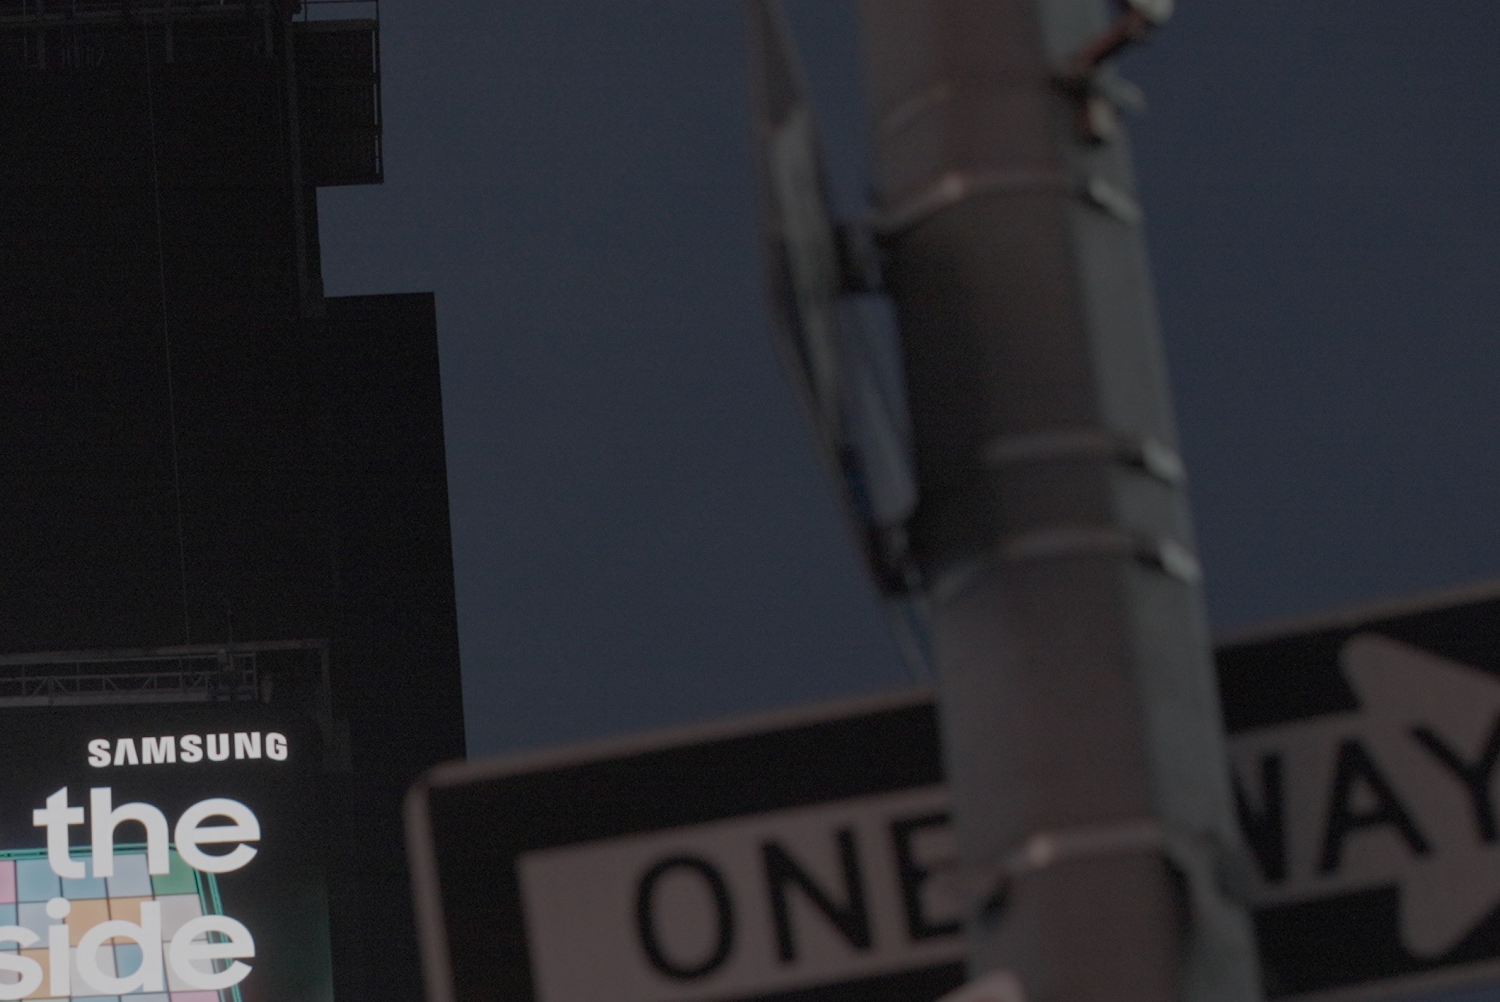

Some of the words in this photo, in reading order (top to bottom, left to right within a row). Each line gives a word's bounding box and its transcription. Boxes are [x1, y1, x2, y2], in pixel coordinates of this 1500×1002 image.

[87, 731, 289, 768] SAMSUNG
[32, 786, 261, 880] the
[636, 811, 965, 981] ONE
